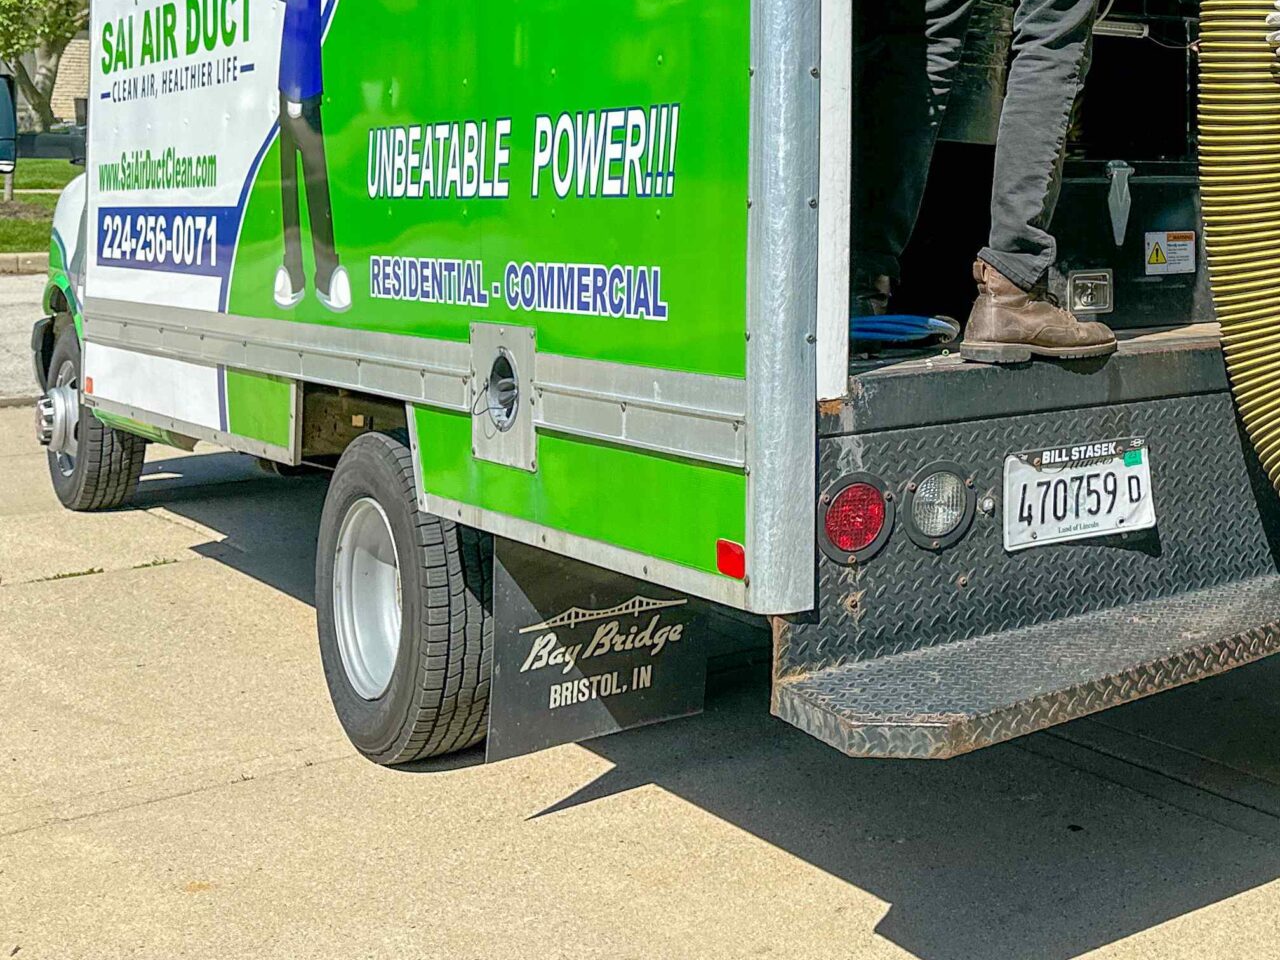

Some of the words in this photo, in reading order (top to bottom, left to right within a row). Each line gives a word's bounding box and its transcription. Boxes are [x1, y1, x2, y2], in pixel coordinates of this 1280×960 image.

[101, 15, 133, 75] SAI
[140, 1, 178, 66] AIR
[112, 77, 138, 103] CLEAN
[141, 73, 158, 99] AIR,
[162, 61, 212, 94] HEALTHIER
[217, 56, 238, 84] LIFE
[99, 147, 216, 192] www.SaiAirDuctClean.com
[366, 117, 512, 200] UNBEATABLE
[531, 103, 680, 199] POWER!!!
[102, 215, 217, 266] 224-256-0071
[370, 256, 489, 307] RESIDENTIAL
[504, 261, 668, 321] COMMERCIAL
[1042, 450, 1069, 464] BILL
[1071, 442, 1116, 460] STASEK
[1018, 471, 1117, 526] 470759
[1128, 475, 1141, 503] D
[1058, 524, 1072, 534] Land
[1073, 523, 1078, 531] of
[1079, 520, 1099, 530] Lincoln
[520, 632, 582, 673] Bay
[582, 614, 683, 657] Bridge
[549, 671, 627, 709] BRISTOL,
[632, 664, 652, 690] IN
